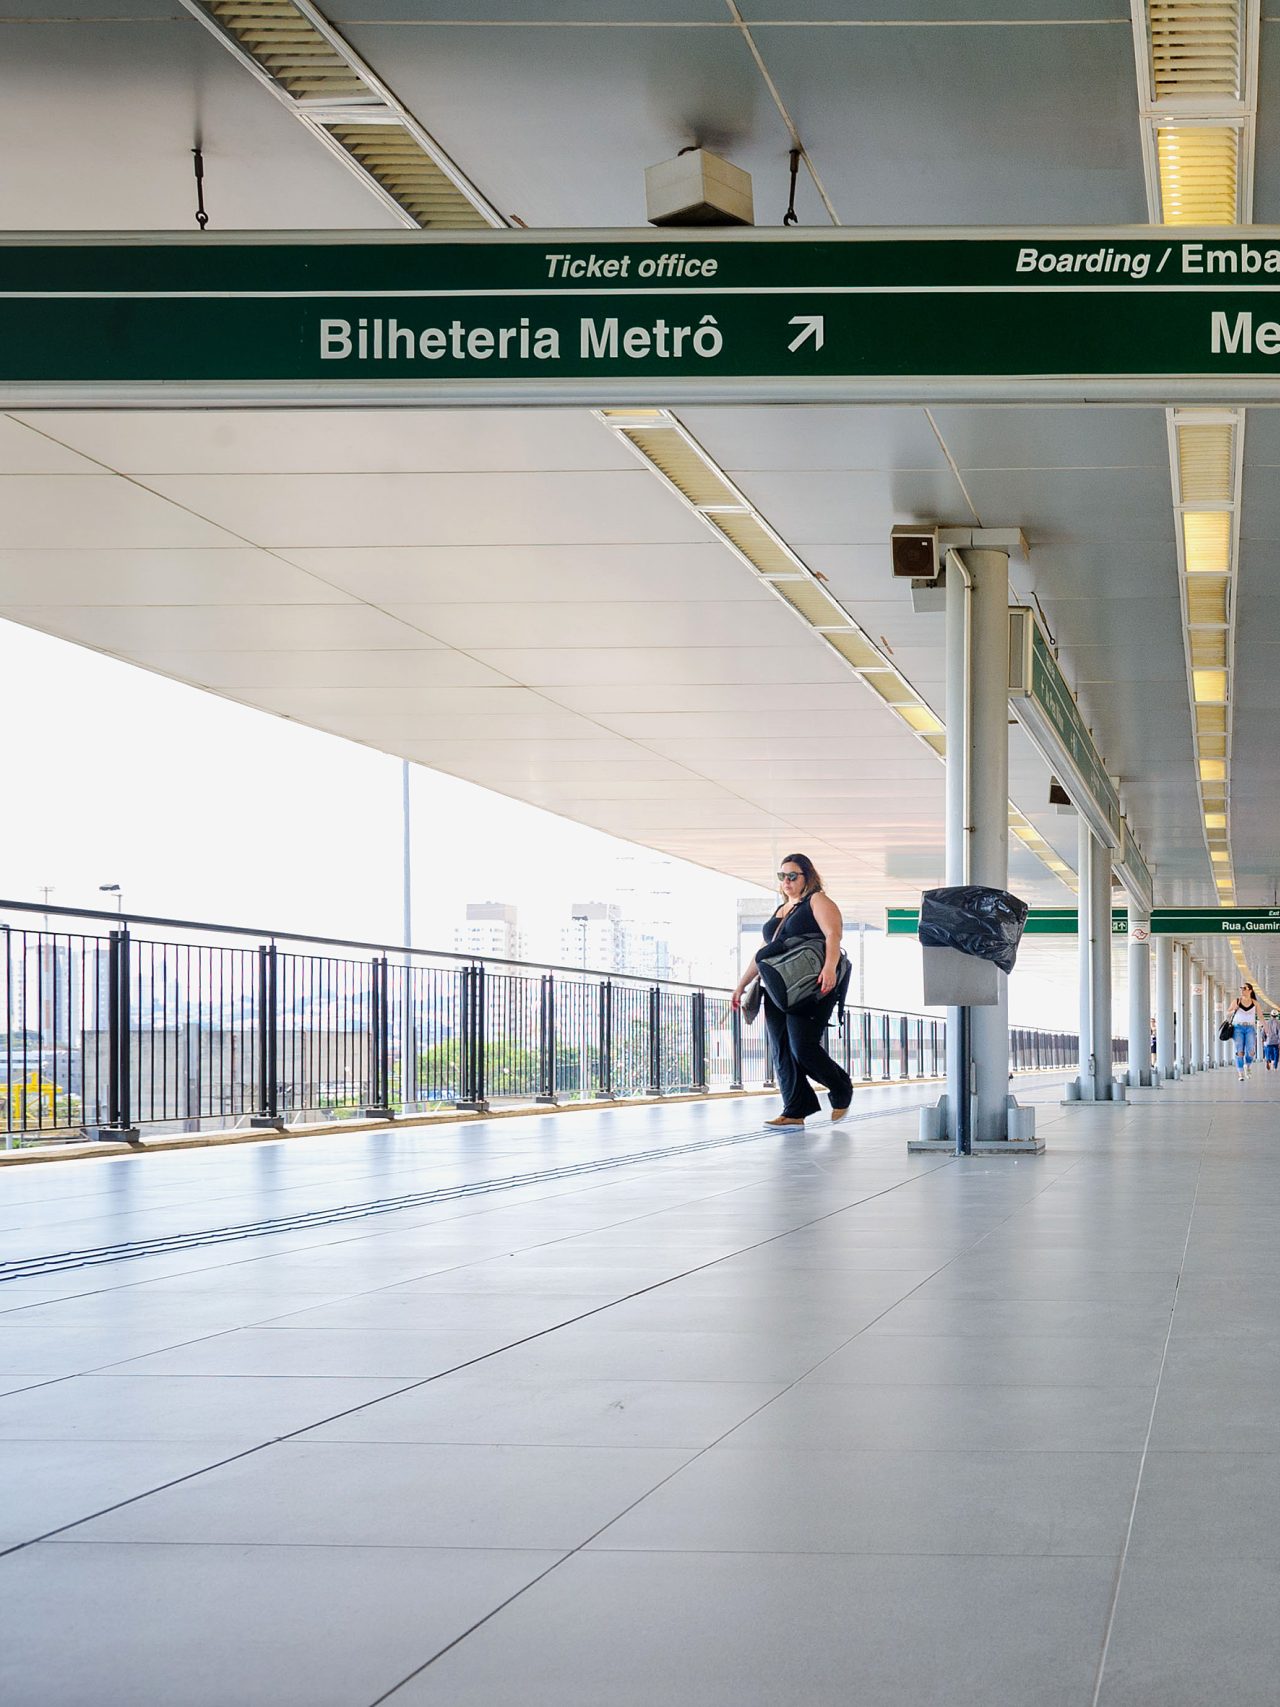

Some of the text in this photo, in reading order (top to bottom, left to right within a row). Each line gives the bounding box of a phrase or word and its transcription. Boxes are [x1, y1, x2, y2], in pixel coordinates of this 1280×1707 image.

[545, 253, 718, 278] Ticket office
[1015, 248, 1151, 279] Boarding
[320, 314, 723, 360] Bilheteria Metrô
[1221, 921, 1241, 930] Rua
